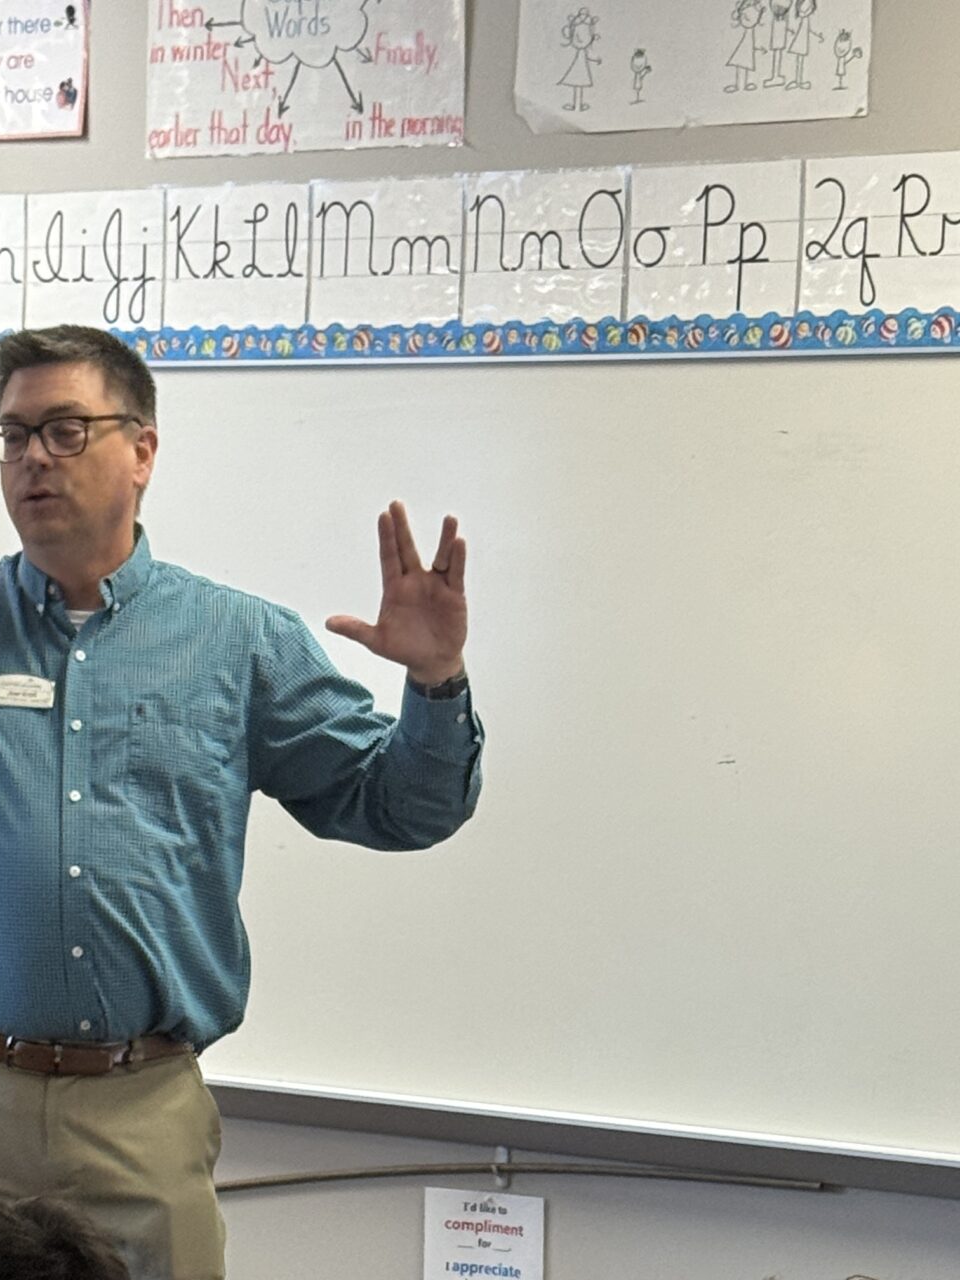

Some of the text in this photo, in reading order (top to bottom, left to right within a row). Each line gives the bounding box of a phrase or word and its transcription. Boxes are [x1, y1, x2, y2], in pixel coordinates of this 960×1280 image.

[157, 0, 204, 30] Then
[264, 4, 331, 39] Words
[8, 16, 52, 35] there
[172, 32, 230, 62] winter
[6, 53, 35, 70] are
[4, 86, 53, 104] house
[149, 112, 200, 148] earlier
[209, 109, 248, 145] that
[345, 113, 362, 141] in
[369, 102, 396, 139] the
[463, 1201, 508, 1216] I'd like to
[444, 1218, 524, 1238] compliment
[478, 1238, 491, 1249] for
[445, 1261, 522, 1280] I appreciate
